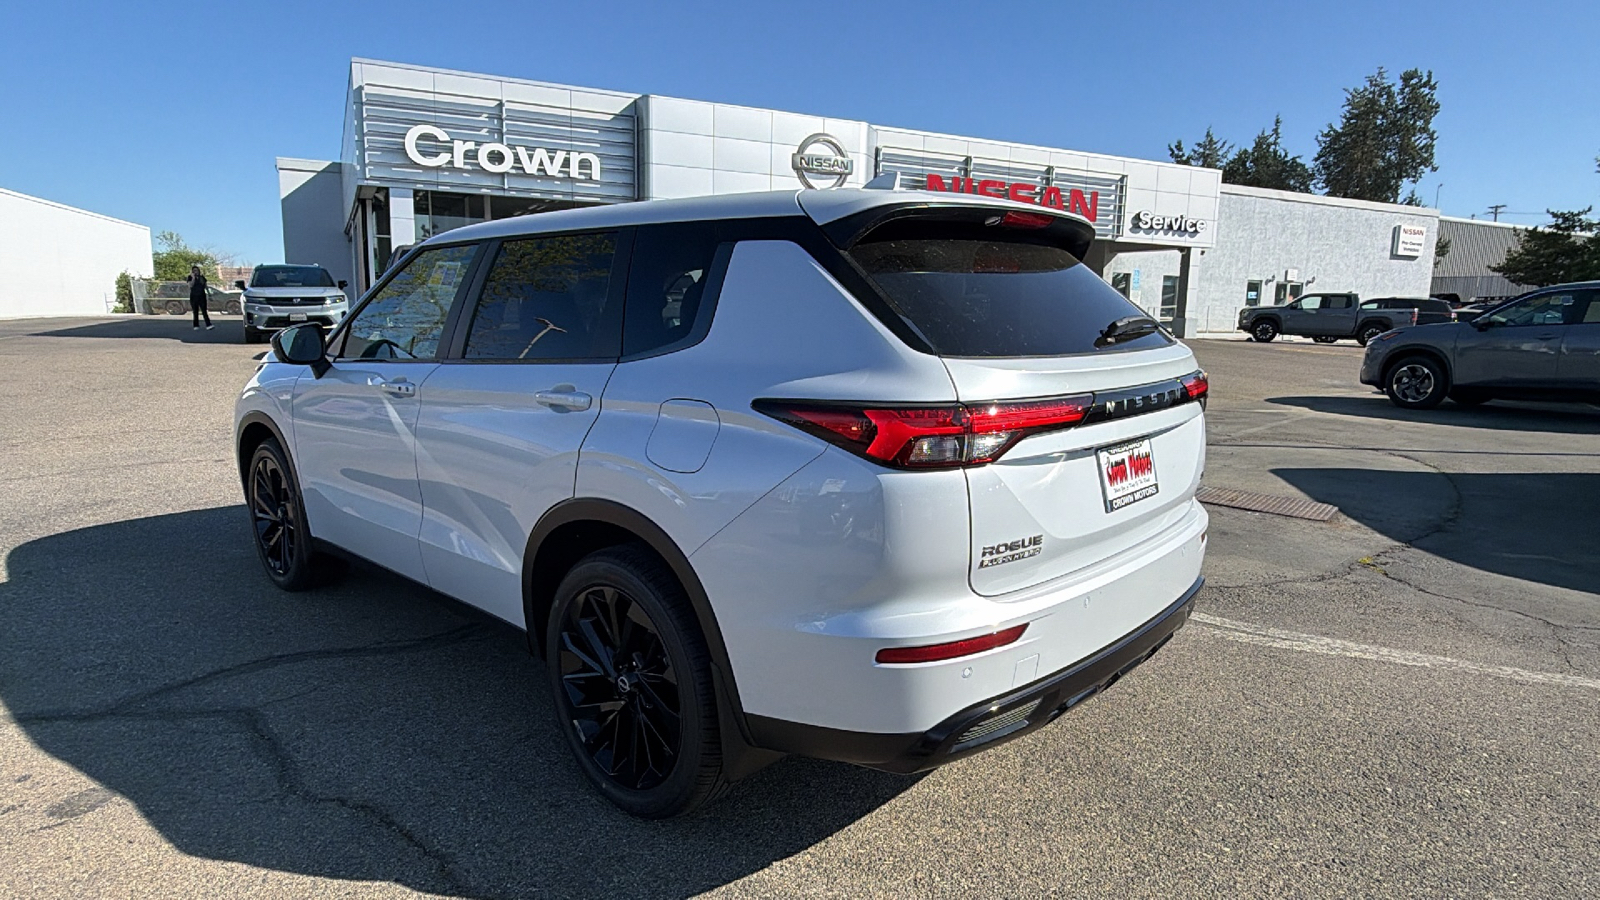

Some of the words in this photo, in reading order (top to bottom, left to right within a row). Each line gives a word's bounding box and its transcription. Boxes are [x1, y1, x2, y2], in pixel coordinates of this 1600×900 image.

[404, 124, 601, 181] Crown
[799, 156, 849, 171] NISSAN
[1138, 211, 1208, 233] Service
[1403, 228, 1424, 236] NISSAN
[1106, 388, 1180, 413] NISSAN
[1112, 494, 1134, 509] CROWN
[1133, 485, 1157, 501] MOTORS
[982, 534, 1043, 557] ROGUE
[1013, 547, 1041, 561] HYBRID
